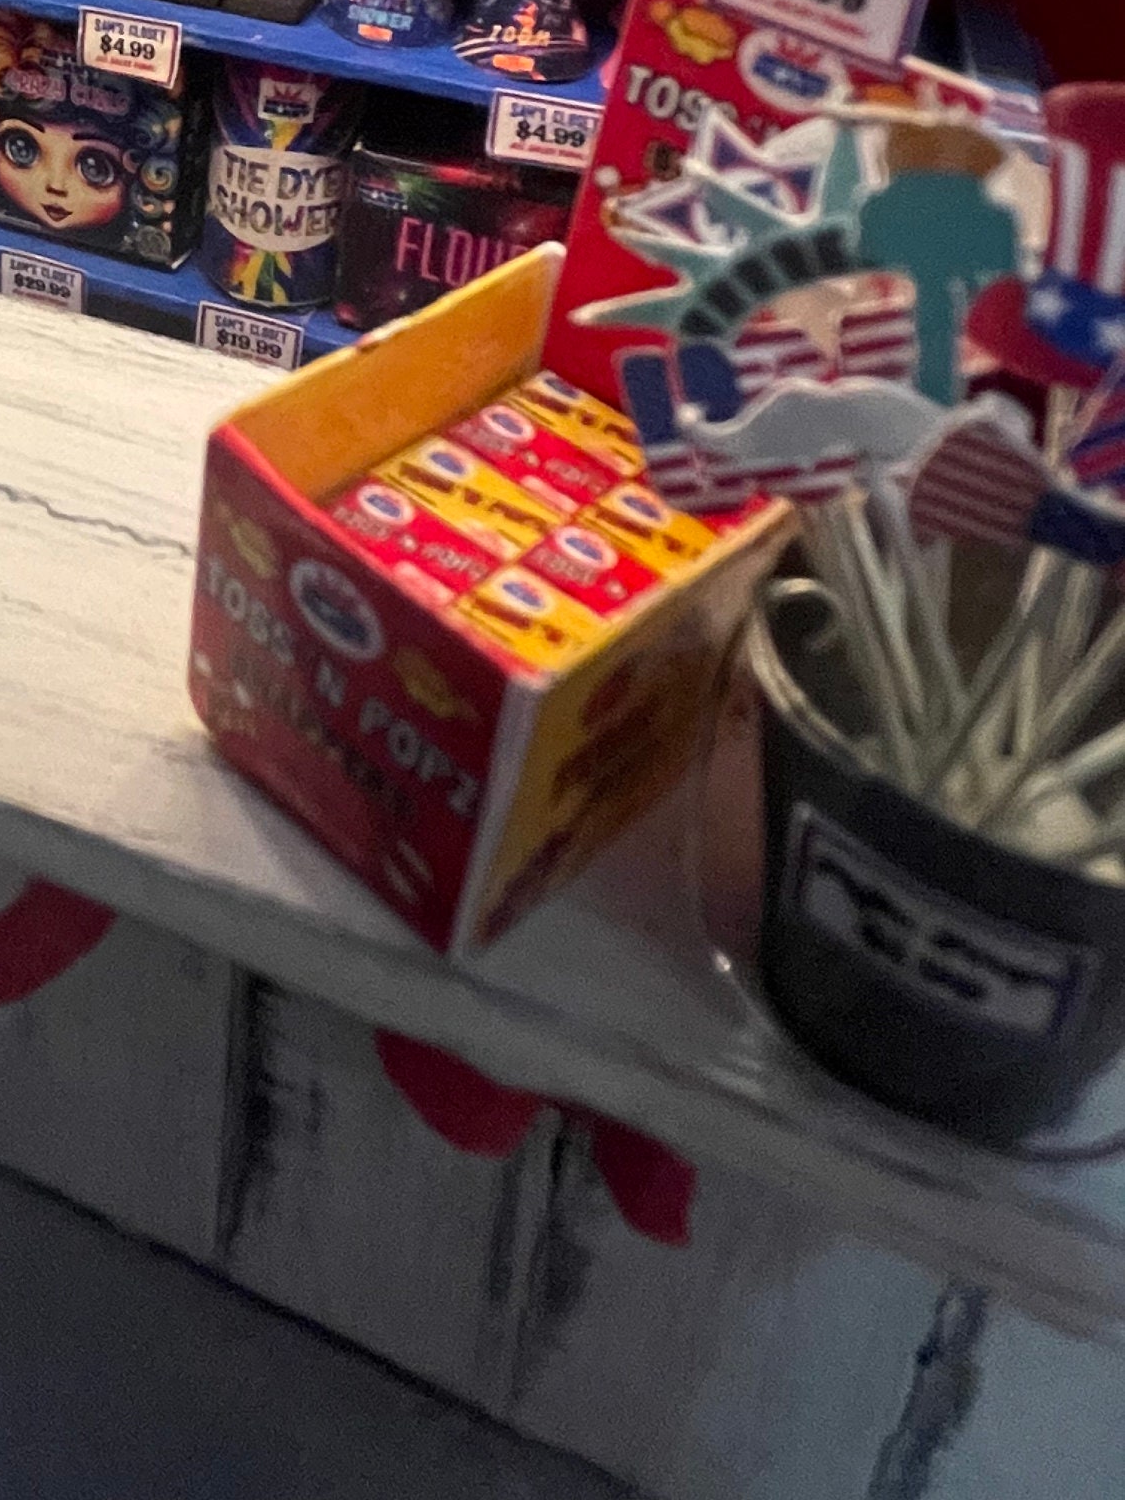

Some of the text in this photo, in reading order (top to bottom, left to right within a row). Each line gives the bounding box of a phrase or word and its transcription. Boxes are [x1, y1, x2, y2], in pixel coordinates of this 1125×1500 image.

[100, 34, 156, 60] $4.99
[625, 65, 738, 133] TOS
[516, 119, 586, 147] $4.99
[223, 150, 351, 201] TIE DYE
[213, 185, 343, 237] SHOWER
[216, 329, 283, 359] $19.99
[206, 552, 295, 668] TOSS
